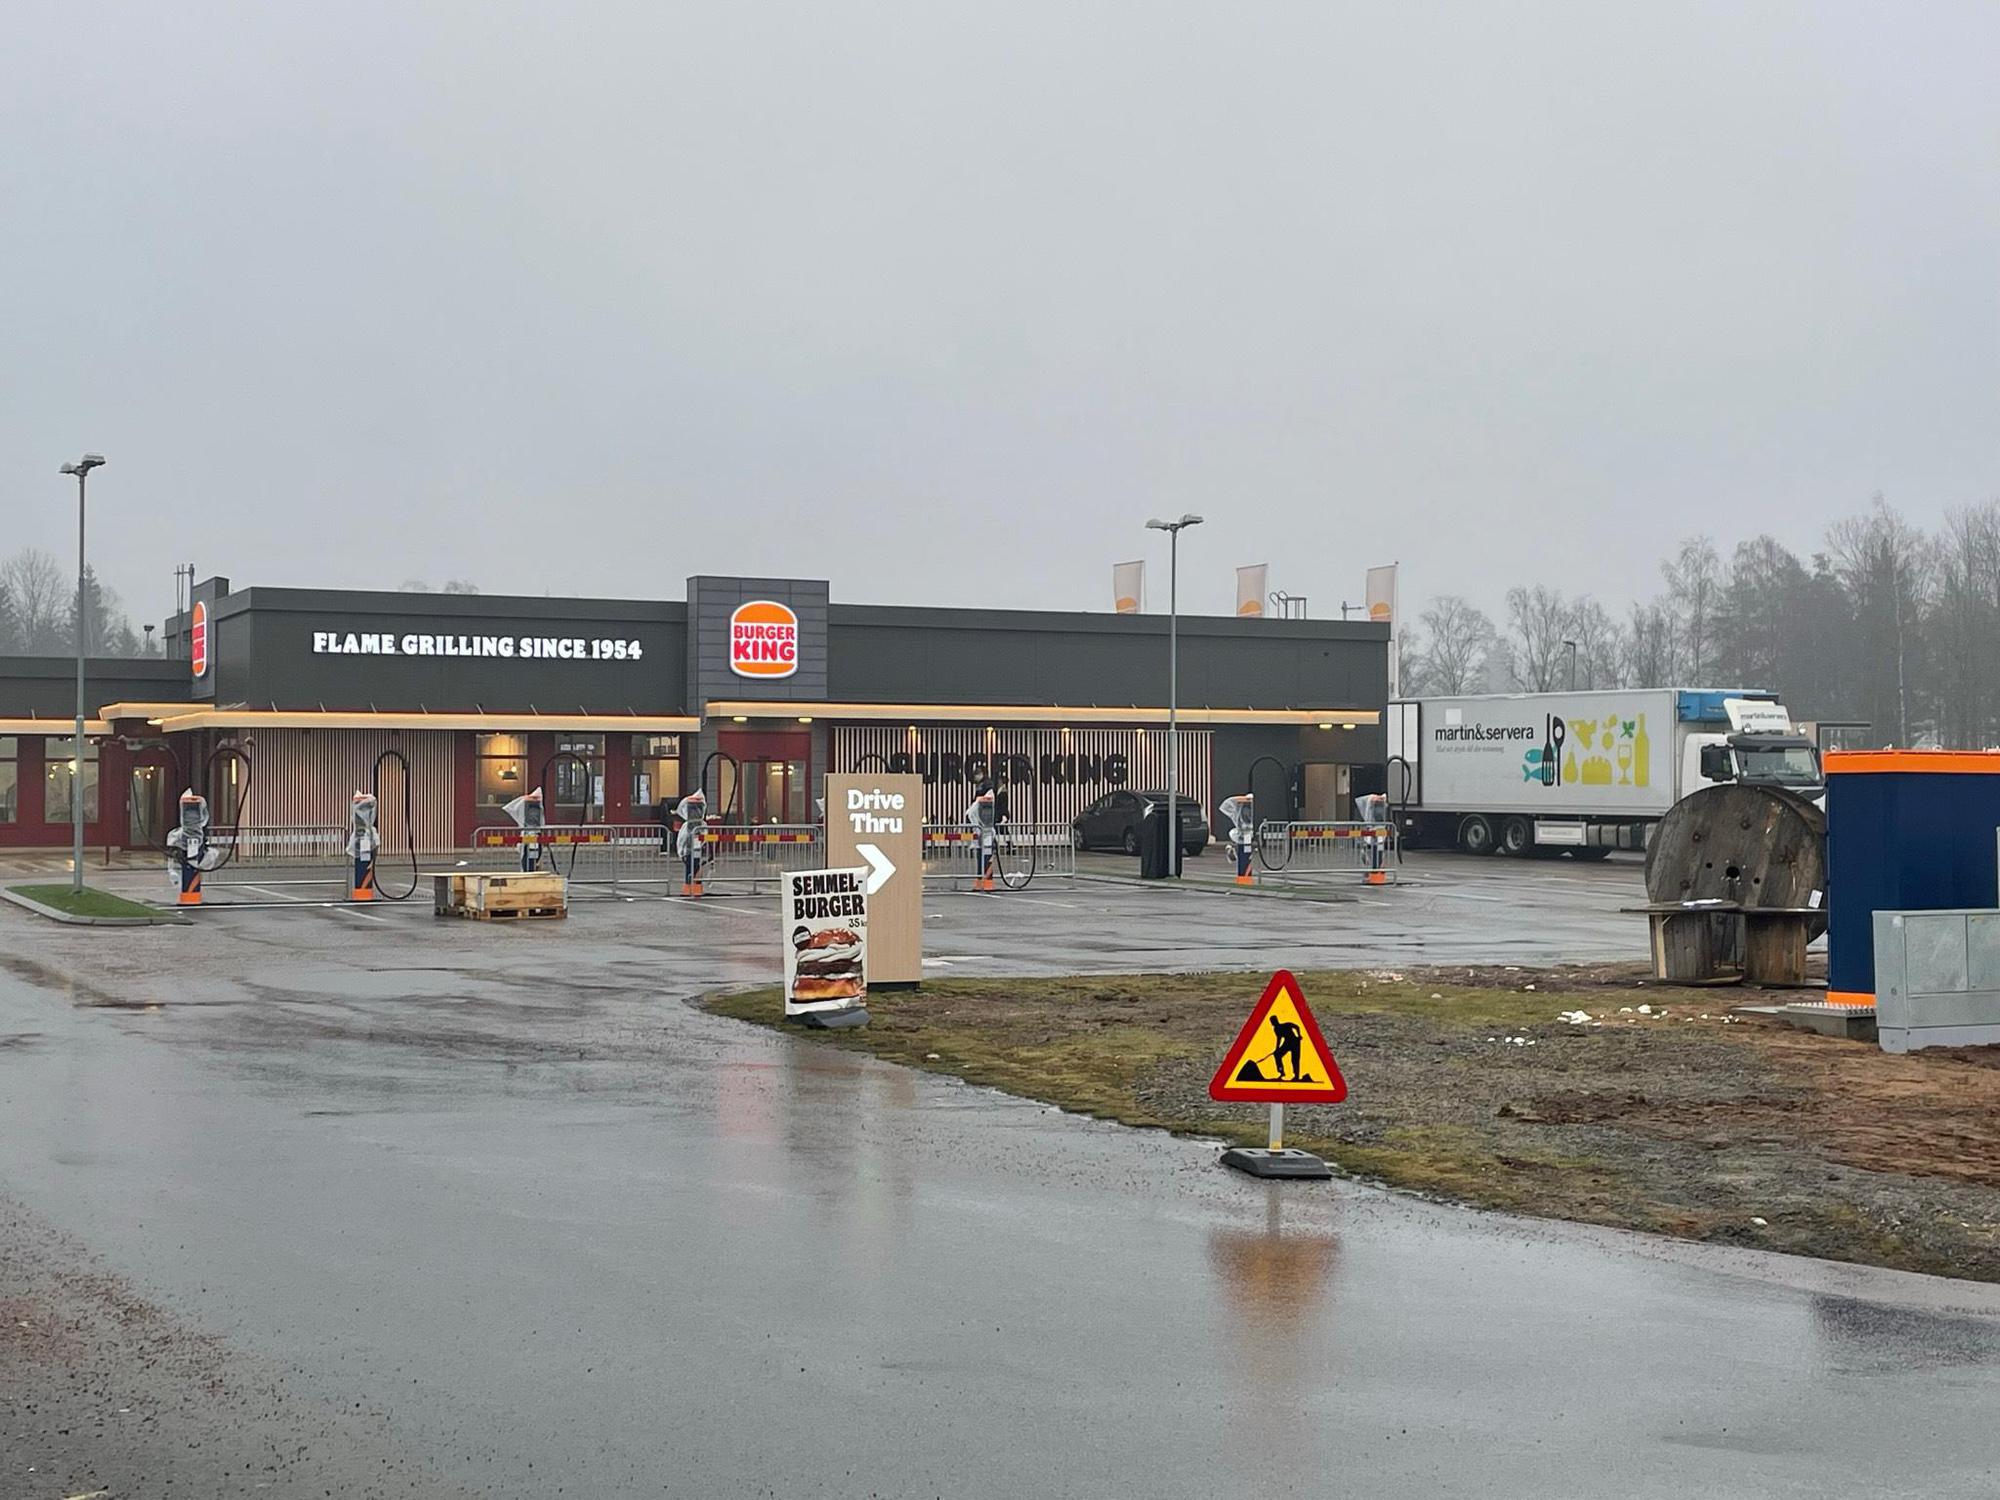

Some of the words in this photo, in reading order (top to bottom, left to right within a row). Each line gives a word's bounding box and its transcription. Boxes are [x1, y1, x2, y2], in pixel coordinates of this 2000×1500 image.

[734, 625, 795, 640] BURGER
[313, 632, 395, 654] FLAME
[401, 635, 514, 657] GRILLING
[519, 637, 586, 658] SINCE
[591, 639, 643, 659] 1954
[734, 640, 795, 661] KING
[1435, 723, 1534, 741] martin&servera
[1041, 753, 1128, 785] KING
[847, 788, 905, 810] Drive
[849, 812, 903, 833] Thru
[792, 873, 863, 896] SEMMEL-
[793, 894, 865, 920] BURGER
